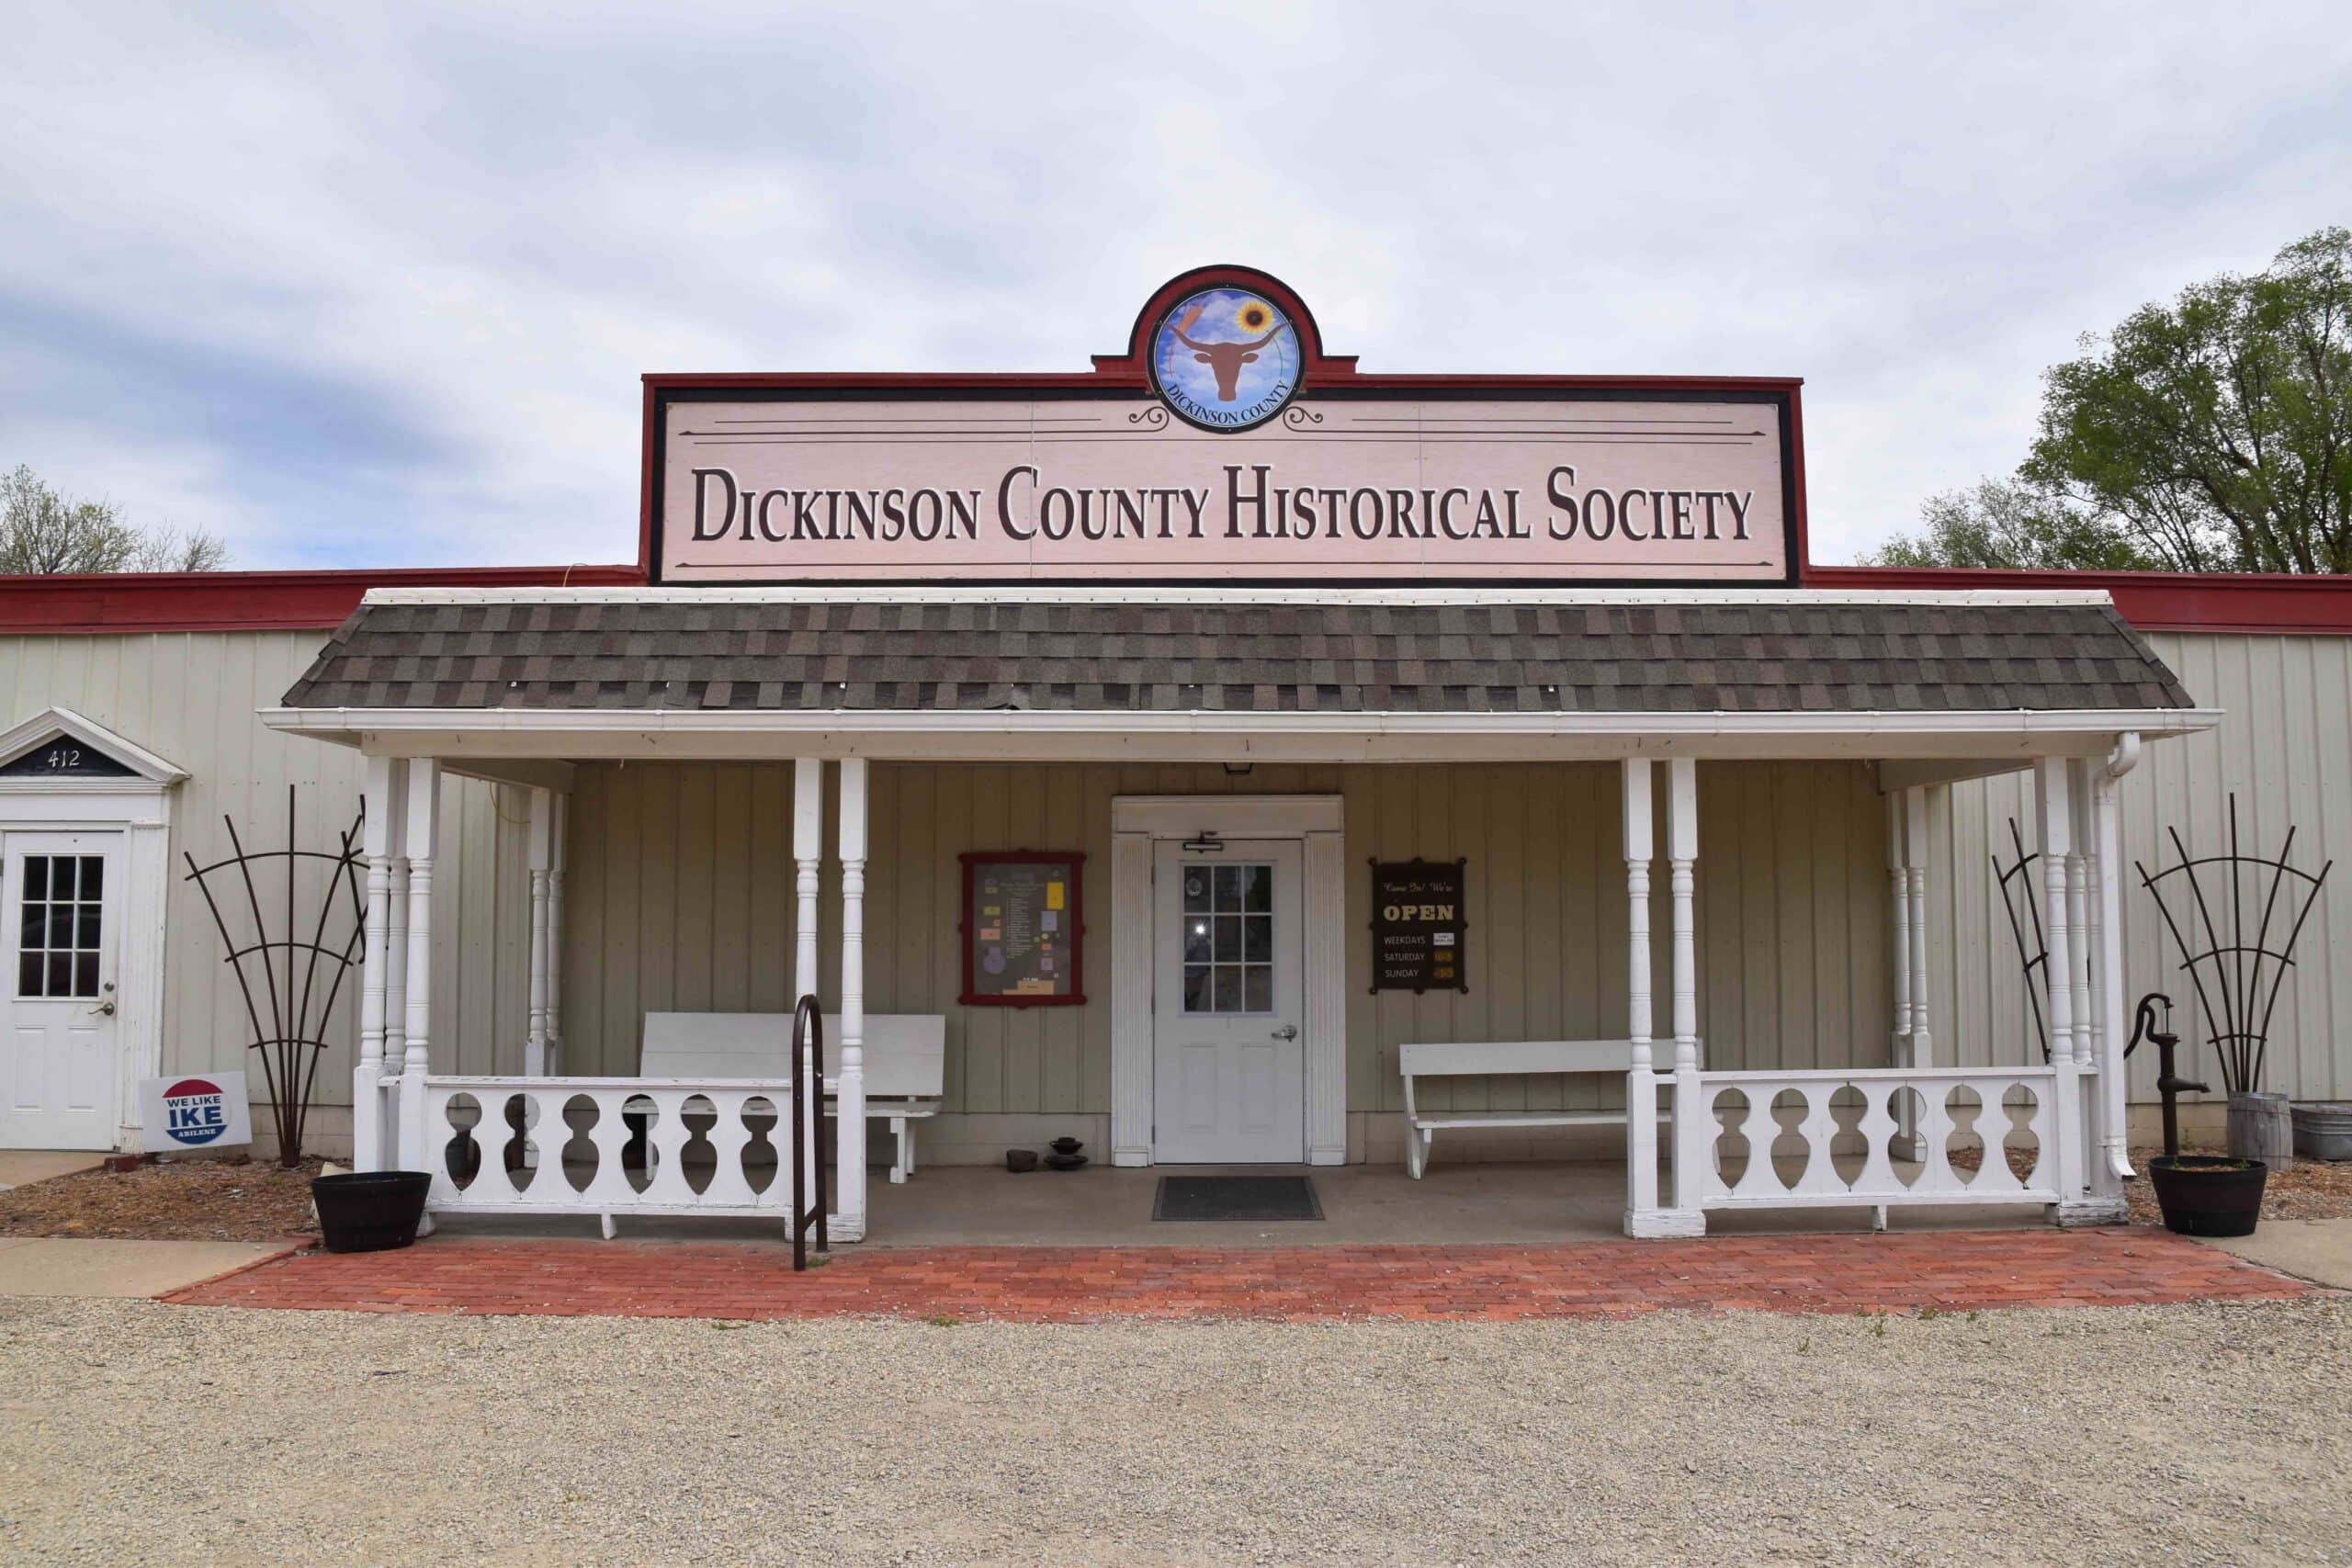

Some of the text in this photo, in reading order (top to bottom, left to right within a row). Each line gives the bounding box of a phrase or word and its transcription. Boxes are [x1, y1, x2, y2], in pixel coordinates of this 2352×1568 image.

[1167, 380, 1290, 423] DICKINSON COUNTY
[691, 464, 1753, 543] DICKINSON COUNTY HISTORICAL SOCIETY
[48, 750, 80, 768] 412
[1383, 905, 1454, 921] OPEN
[1384, 936, 1426, 945] WEEKDAYS
[1384, 953, 1425, 962] SATURDAY
[1385, 969, 1419, 978] SUNDAY
[167, 1095, 221, 1108] WE LIKE
[169, 1105, 223, 1128] IKE
[178, 1128, 217, 1138] ABILENE
